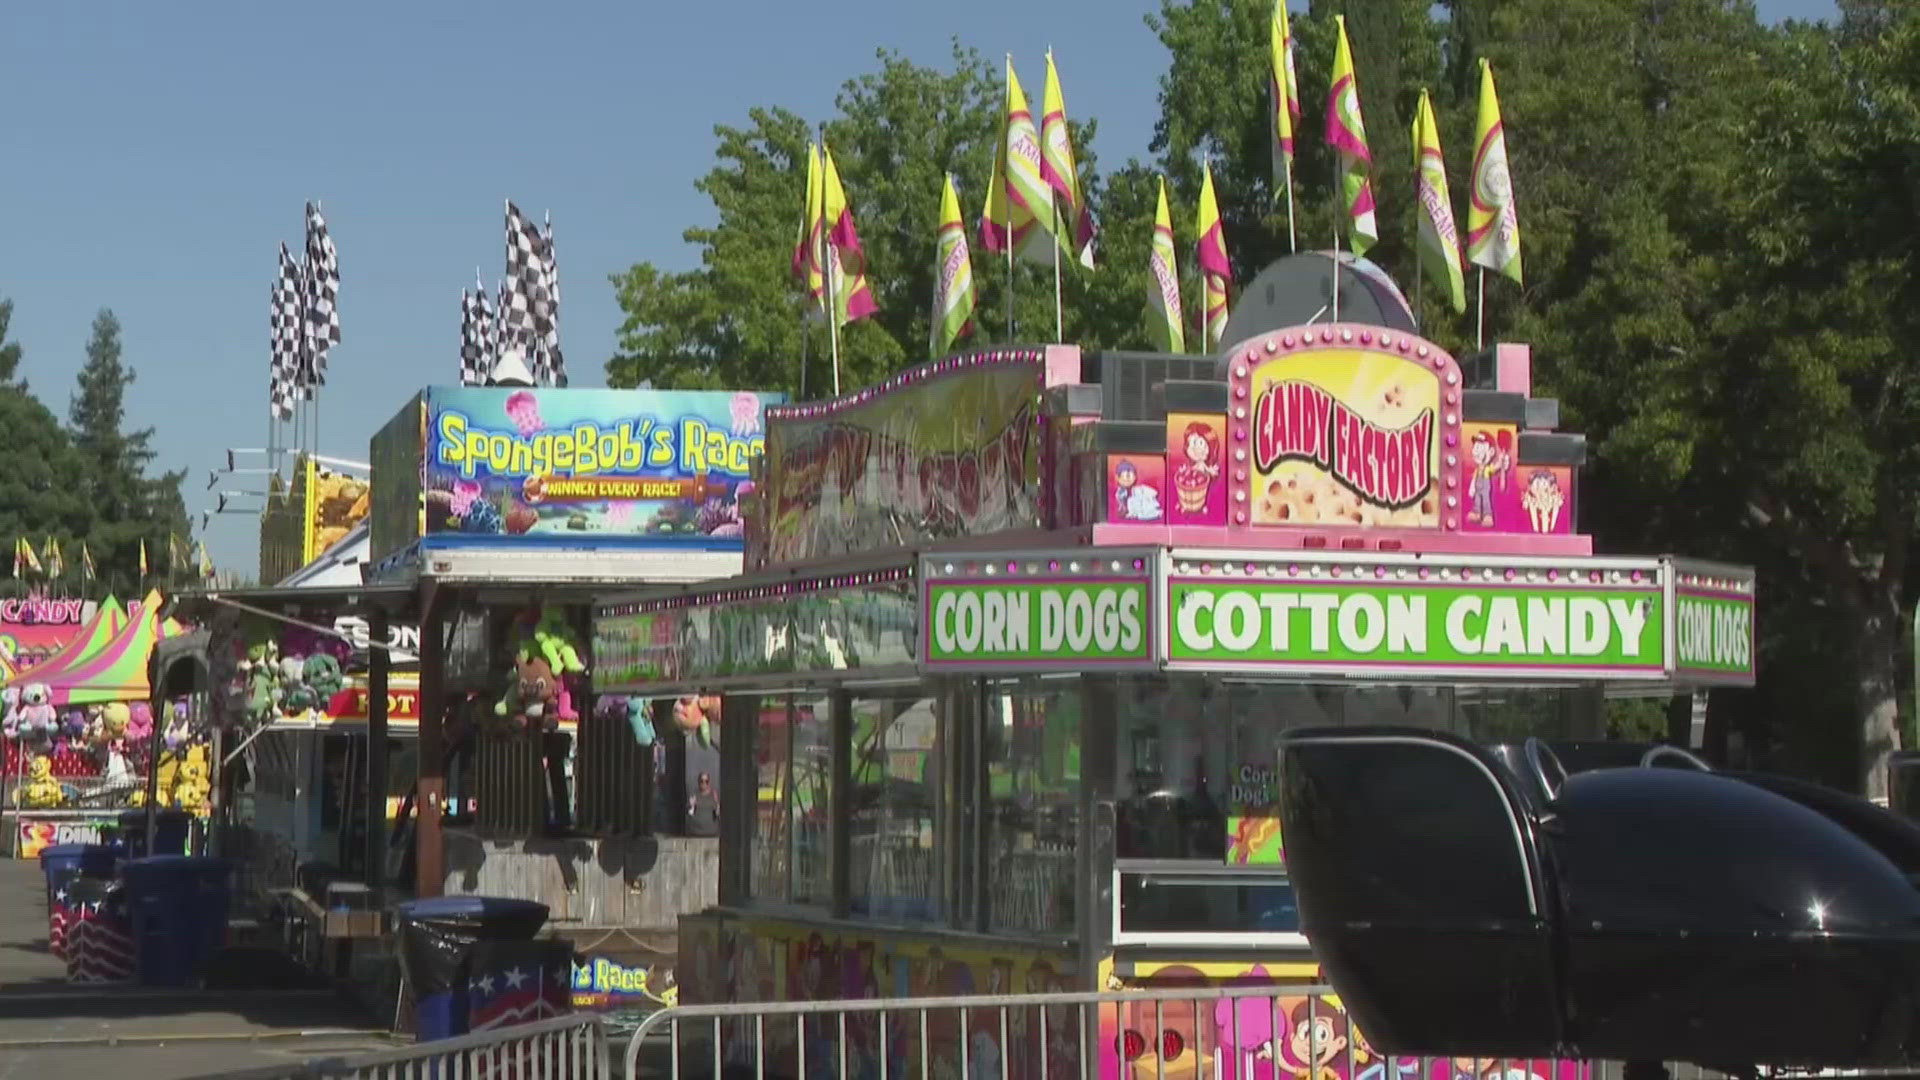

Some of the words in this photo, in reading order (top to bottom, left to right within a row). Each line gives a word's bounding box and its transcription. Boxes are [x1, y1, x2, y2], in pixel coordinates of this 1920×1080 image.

[441, 413, 675, 476] SpongeBob's
[1257, 383, 1331, 467] CANDY
[1335, 402, 1431, 503] FACTORY
[548, 481, 596, 496] WINNER
[599, 482, 640, 497] EVERY
[643, 482, 681, 497] RACE!
[2, 598, 82, 623] CANDY
[935, 590, 1030, 653] CORN
[1040, 587, 1142, 653] DOGS
[1176, 589, 1427, 654] COTTON
[1445, 594, 1649, 657] CANDY
[1678, 599, 1712, 662] CORN
[1714, 603, 1750, 667] DOGS
[597, 959, 647, 992] Race
